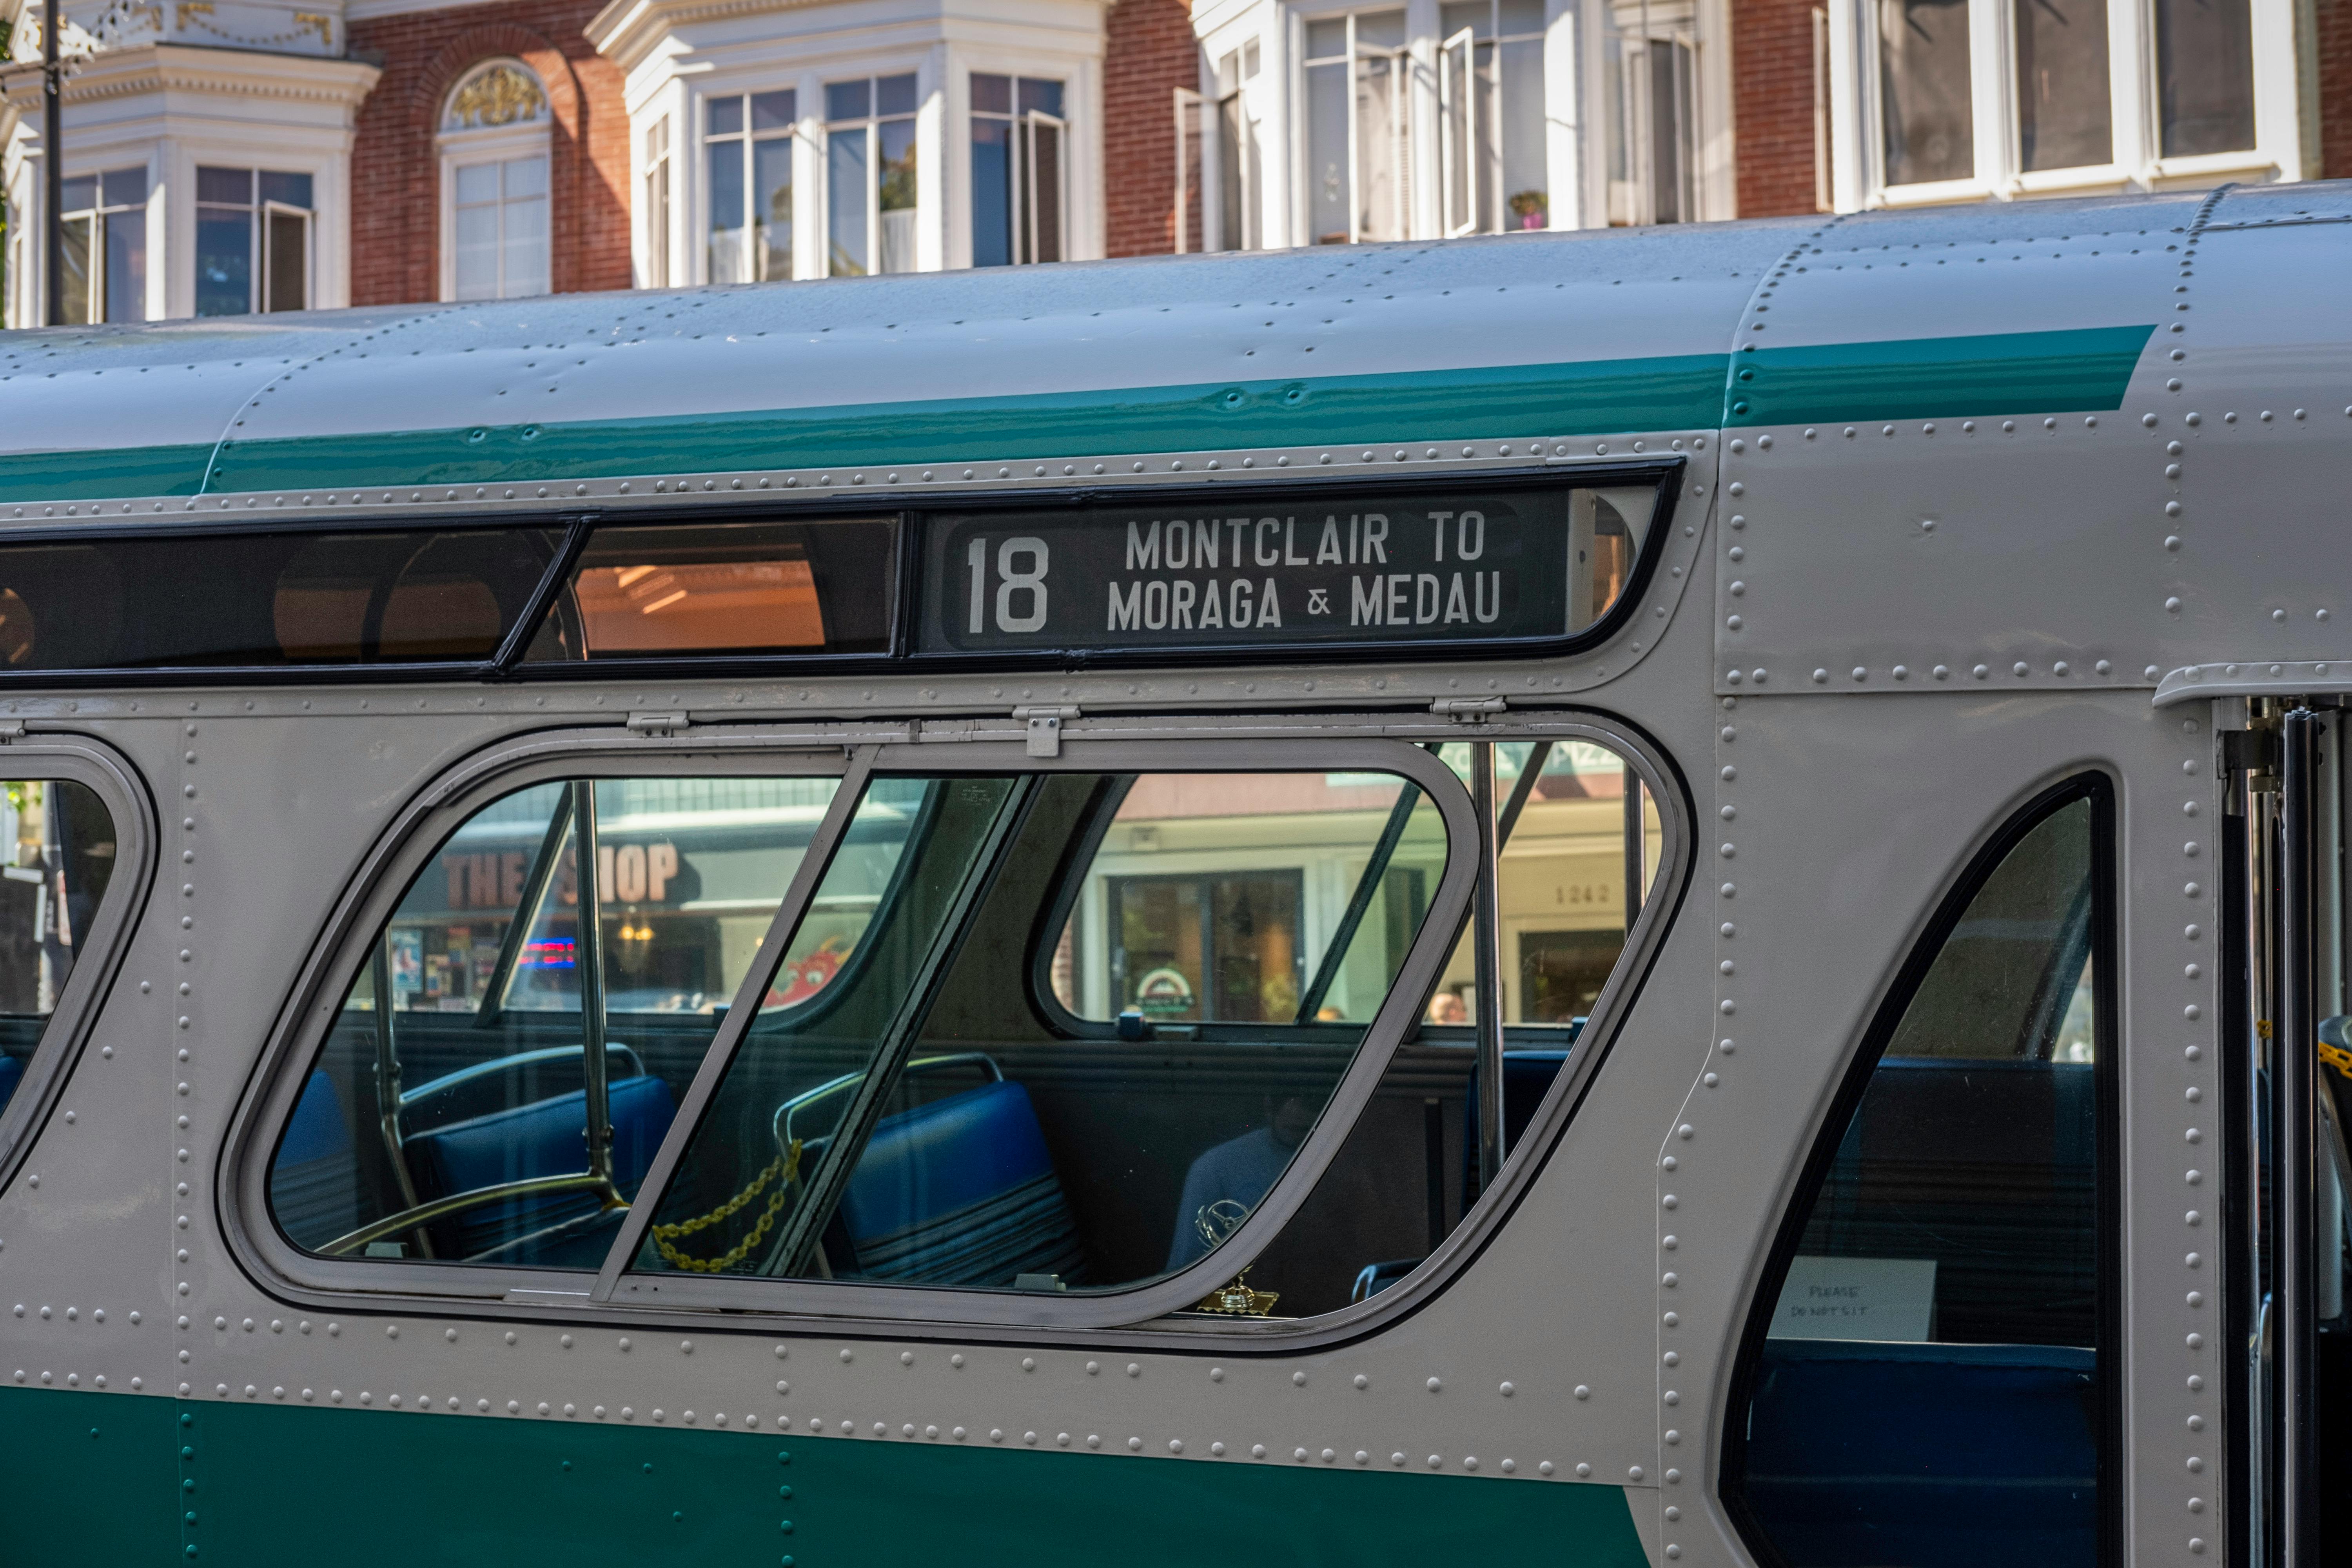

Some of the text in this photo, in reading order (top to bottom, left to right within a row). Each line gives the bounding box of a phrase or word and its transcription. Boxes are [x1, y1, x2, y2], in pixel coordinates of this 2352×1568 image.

[1126, 510, 1485, 570] MONTCLAIR TO
[968, 536, 1049, 633] 18
[1107, 571, 1499, 631] MORAGA & MEDAU
[1552, 742, 1622, 769] PIZZ
[442, 853, 525, 909] THE
[1556, 884, 1610, 904] 1242
[1809, 1285, 1860, 1298] PLEASE
[1810, 1306, 1838, 1317] NOT
[1841, 1305, 1869, 1317] SIT
